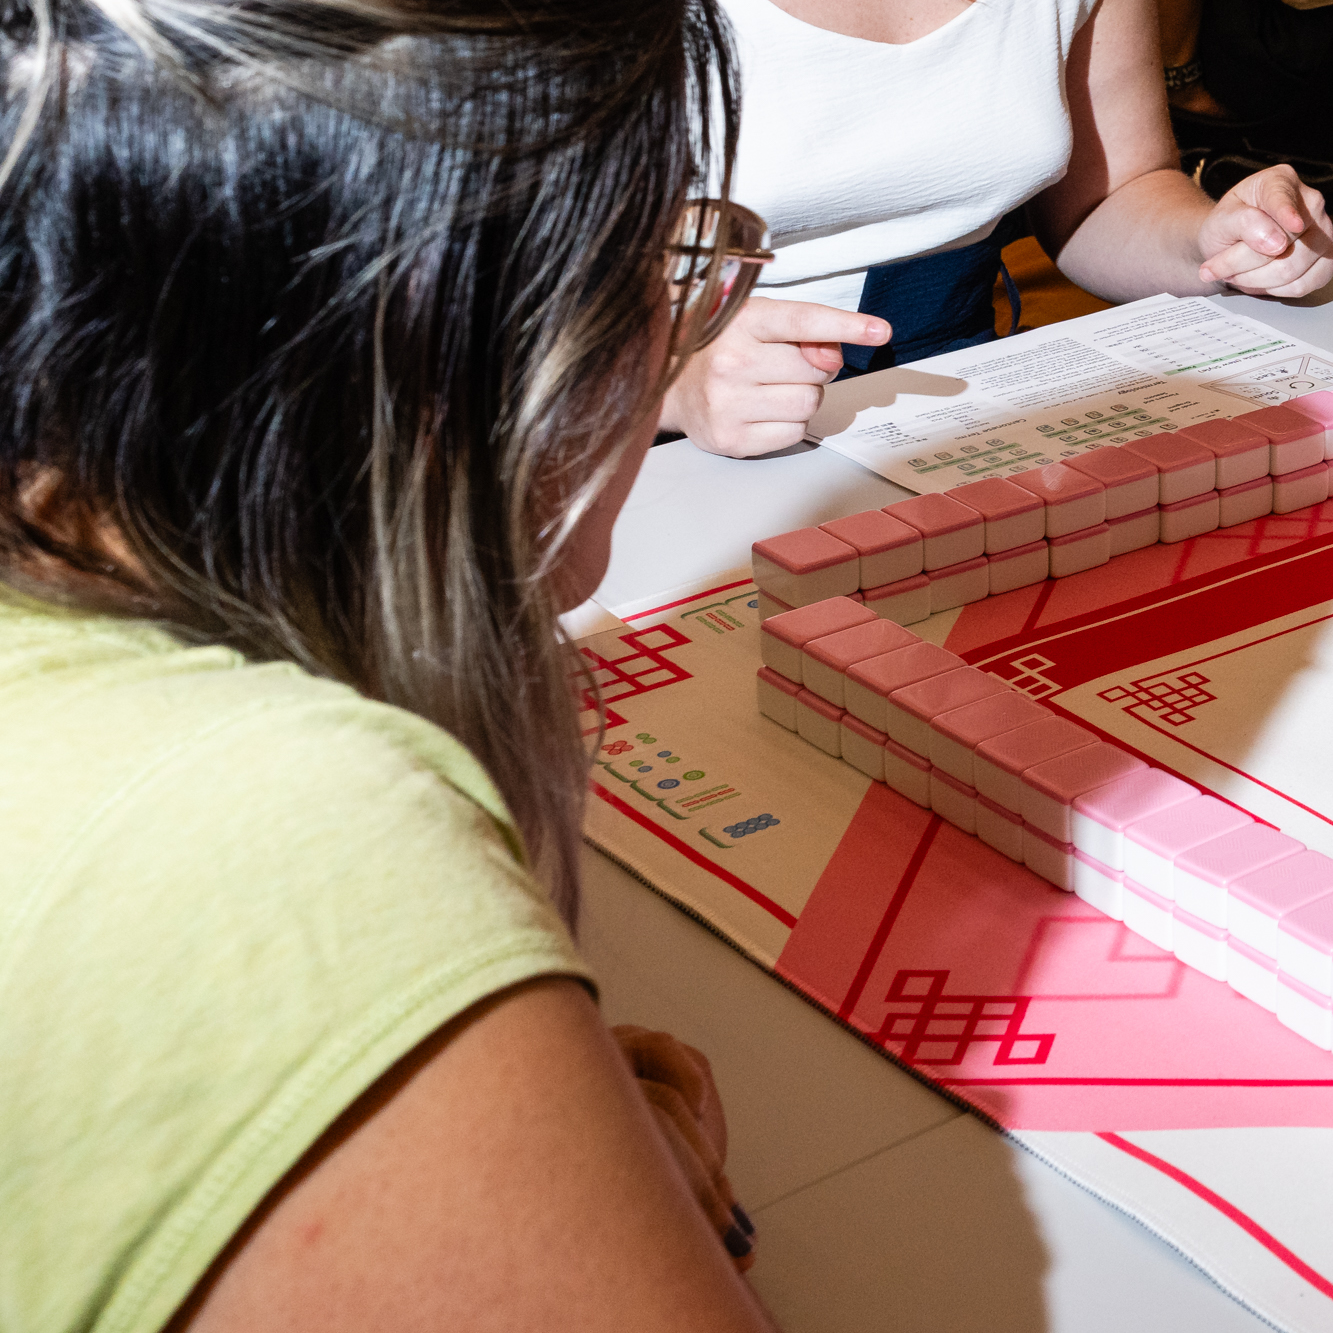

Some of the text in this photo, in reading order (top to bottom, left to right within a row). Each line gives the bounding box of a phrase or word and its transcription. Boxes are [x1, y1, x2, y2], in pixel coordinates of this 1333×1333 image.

[1264, 343, 1296, 354] Payment
[1252, 372, 1276, 381] East
[1117, 380, 1168, 395] Terminology
[955, 418, 1027, 440] Cantonese Terms
